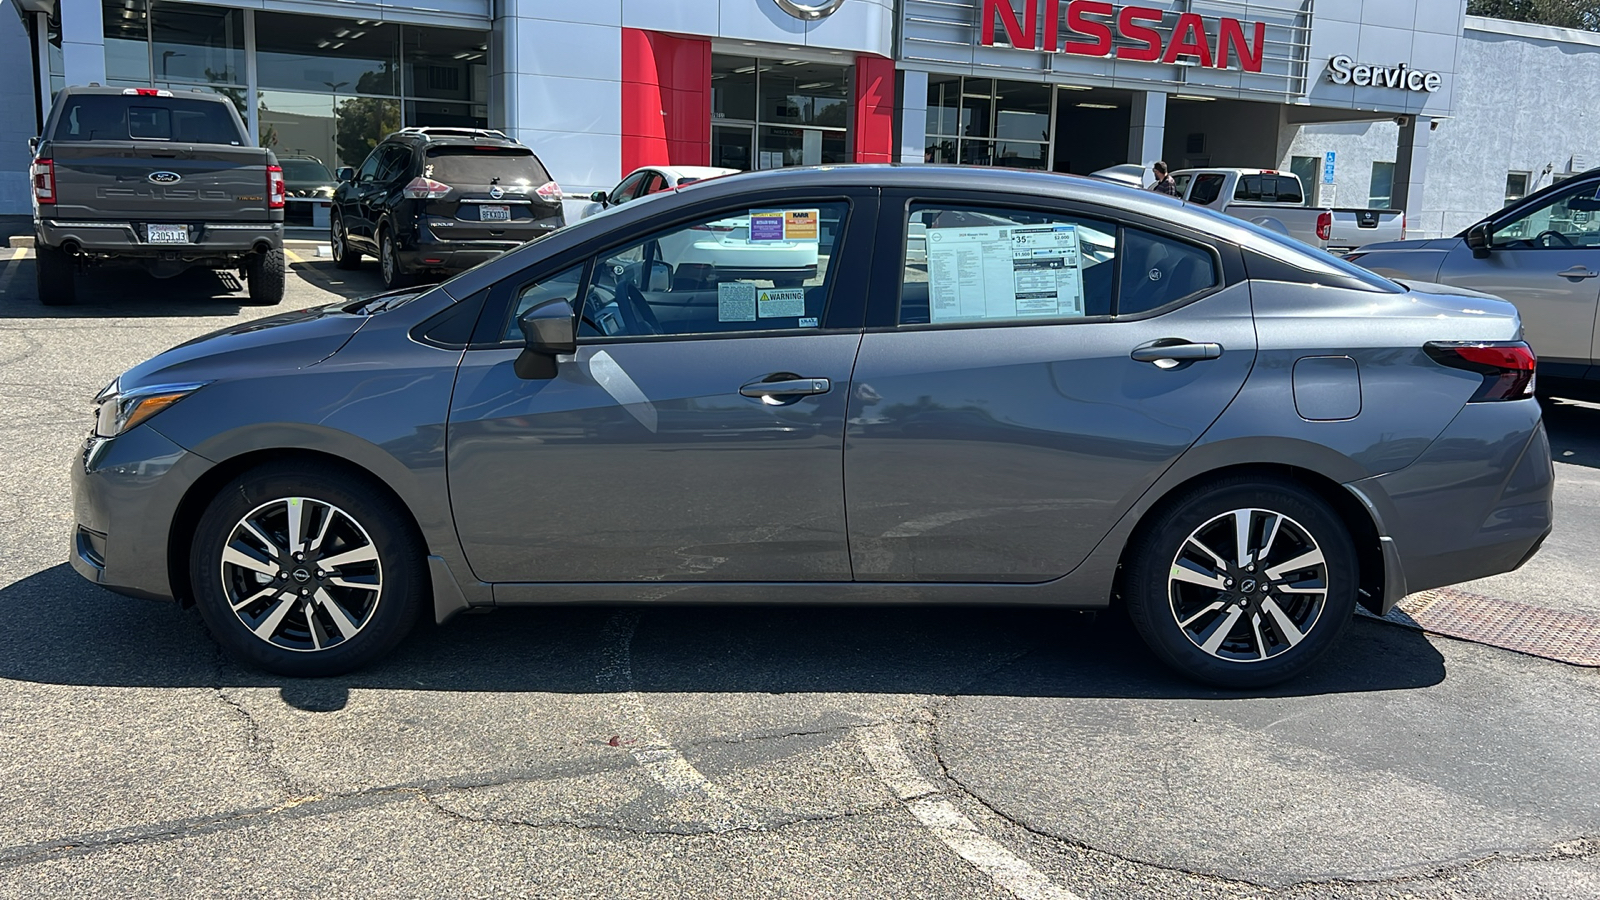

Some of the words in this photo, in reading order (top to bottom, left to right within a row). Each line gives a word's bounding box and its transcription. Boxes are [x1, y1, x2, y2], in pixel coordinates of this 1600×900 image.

[981, 0, 1265, 73] NISSAN
[1330, 54, 1442, 93] Service
[96, 188, 234, 201] F-150
[151, 231, 186, 241] 23051J3
[770, 293, 804, 301] WARNING:
